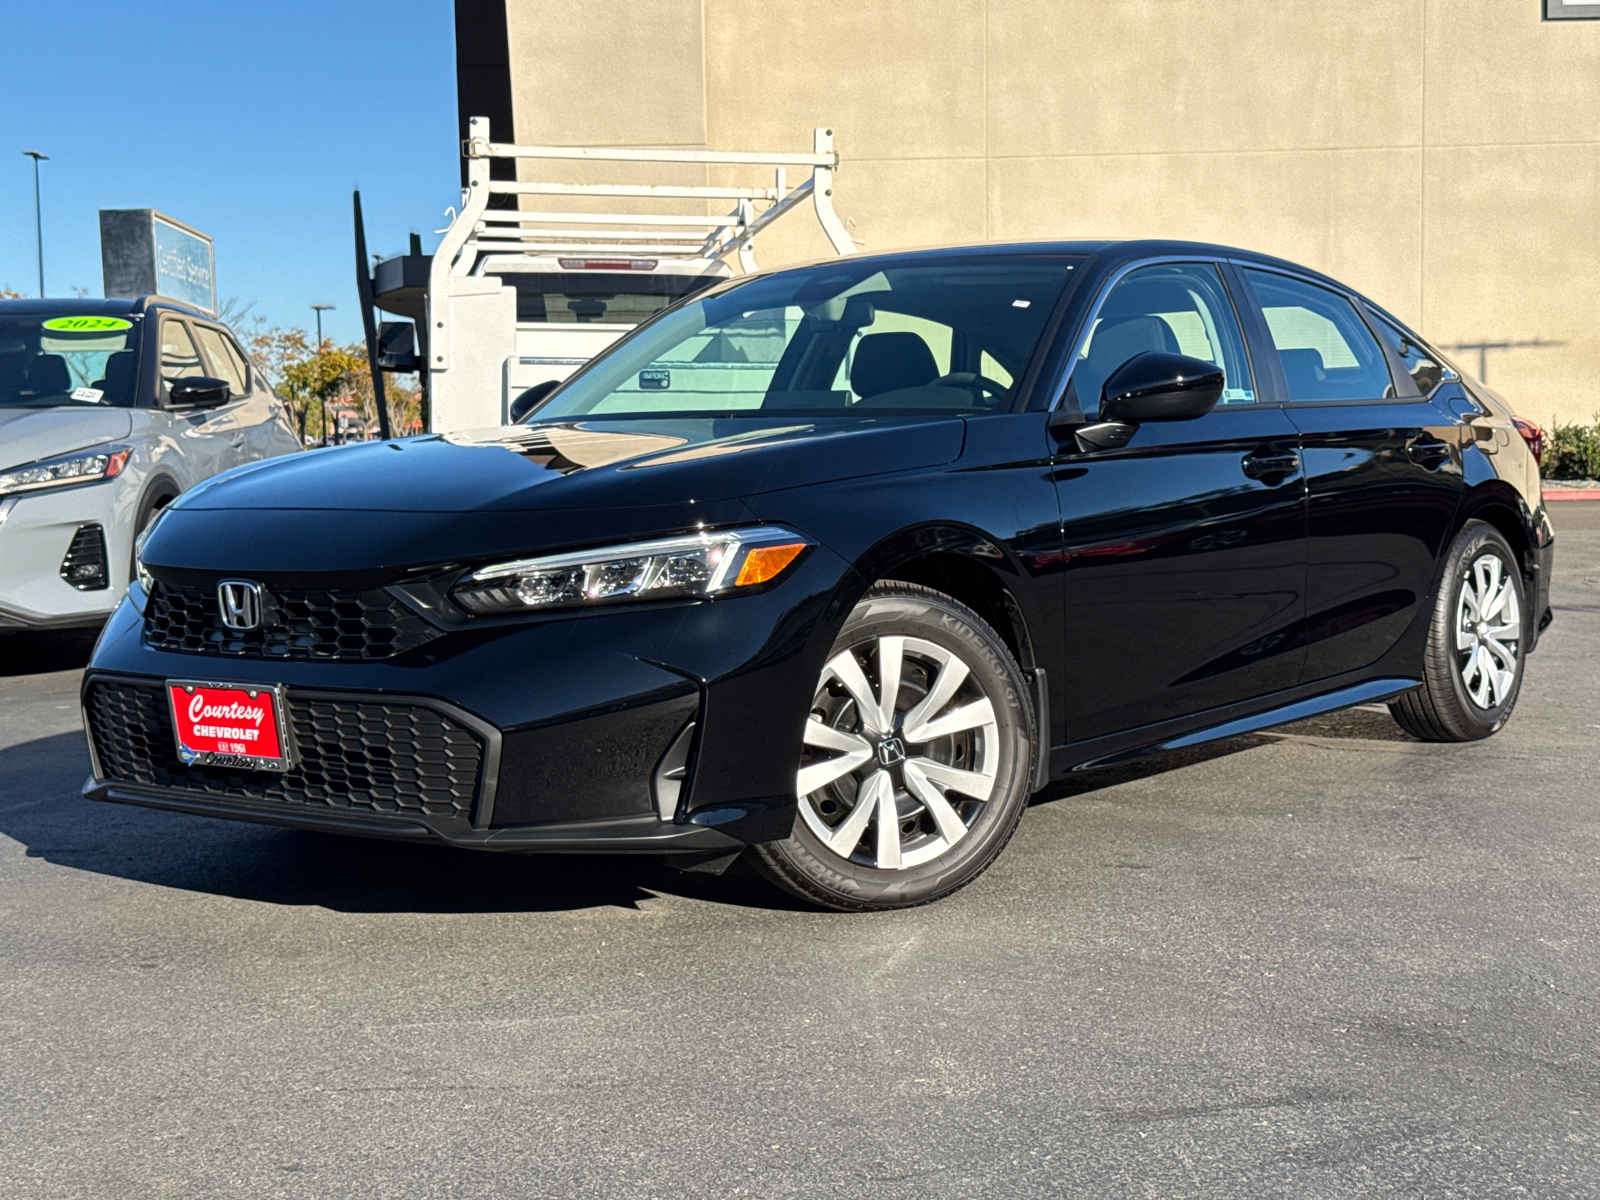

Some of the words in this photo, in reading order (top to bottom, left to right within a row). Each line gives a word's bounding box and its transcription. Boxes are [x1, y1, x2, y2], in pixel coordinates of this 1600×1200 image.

[58, 318, 119, 329] 2024
[1005, 686, 1021, 710] GT
[188, 694, 265, 727] Courtesy
[193, 725, 259, 741] CHEVROLET
[229, 743, 247, 753] 1961
